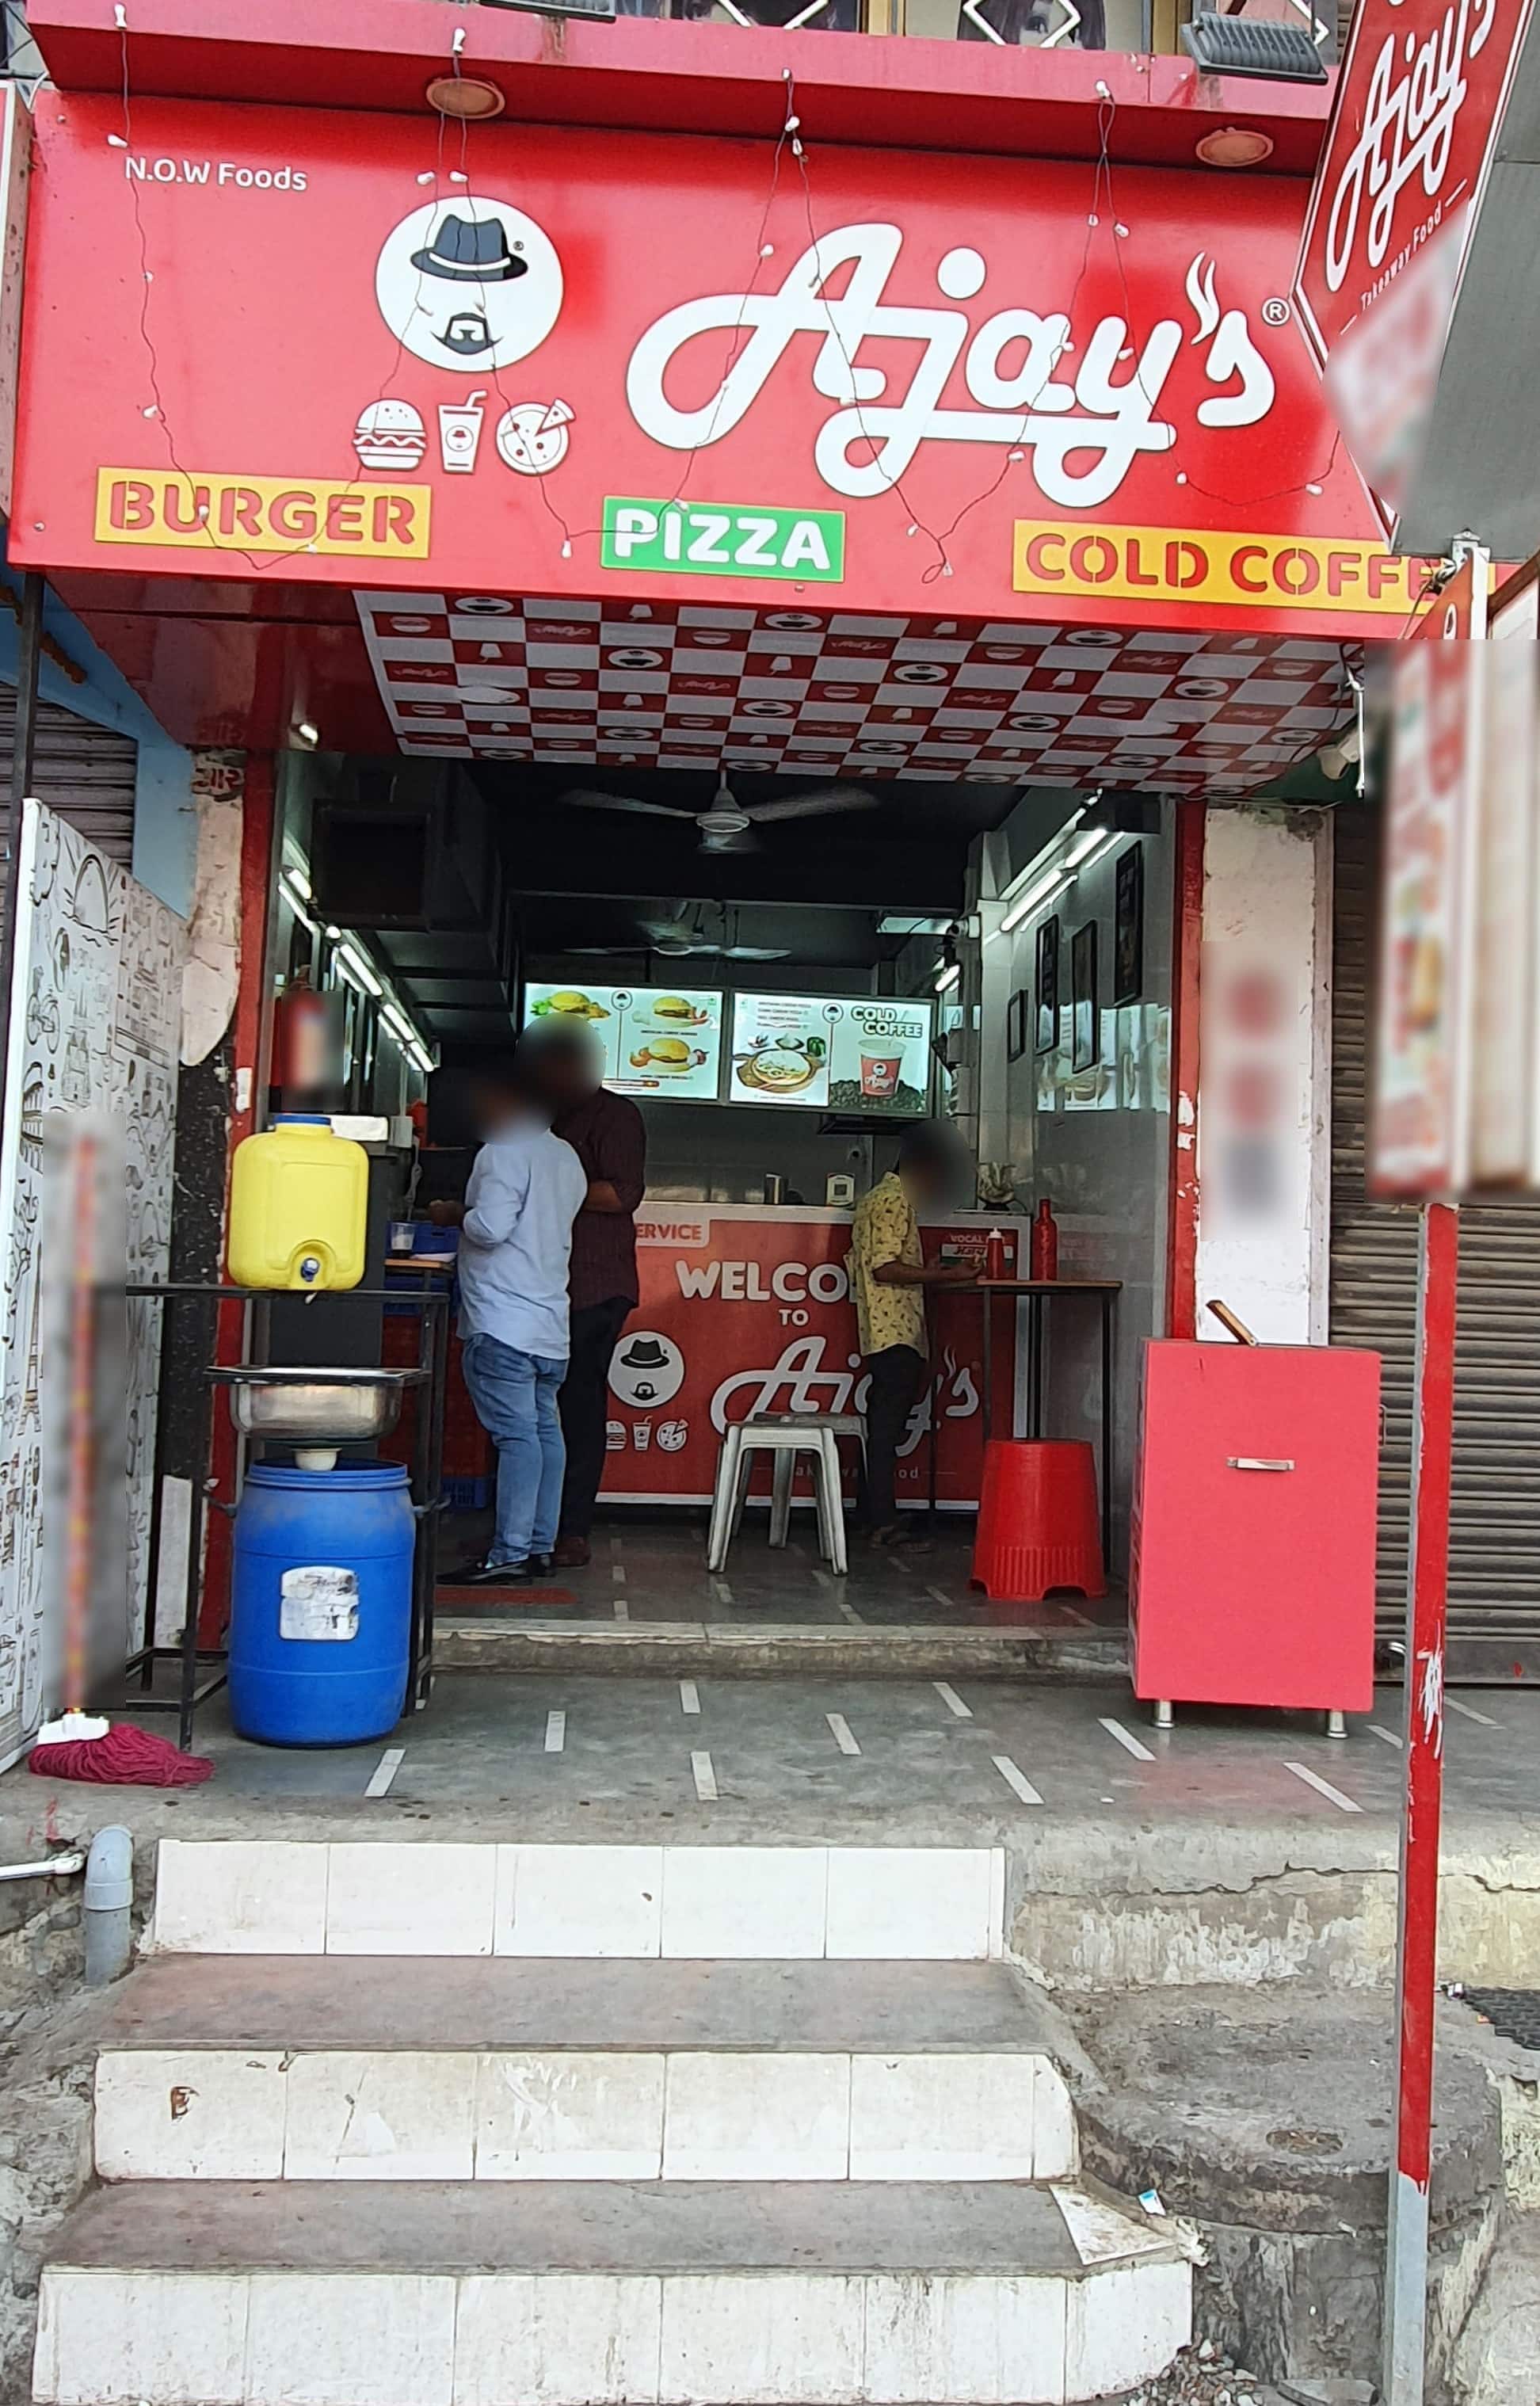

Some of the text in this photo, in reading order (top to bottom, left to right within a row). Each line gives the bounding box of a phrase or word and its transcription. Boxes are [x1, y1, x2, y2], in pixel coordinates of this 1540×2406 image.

[125, 156, 307, 191] N.O.W Foods
[1412, 199, 1442, 252] Food
[625, 222, 1276, 509] Ajay's
[109, 480, 417, 545] BURGER
[612, 508, 833, 570] PIZZA
[1026, 532, 1440, 602] COLD COFFE
[851, 1005, 897, 1022] COLD
[863, 1020, 923, 1038] COFFEE
[635, 1222, 702, 1241] ERVICE
[676, 1260, 856, 1303] WELCO
[779, 1309, 809, 1326] TO
